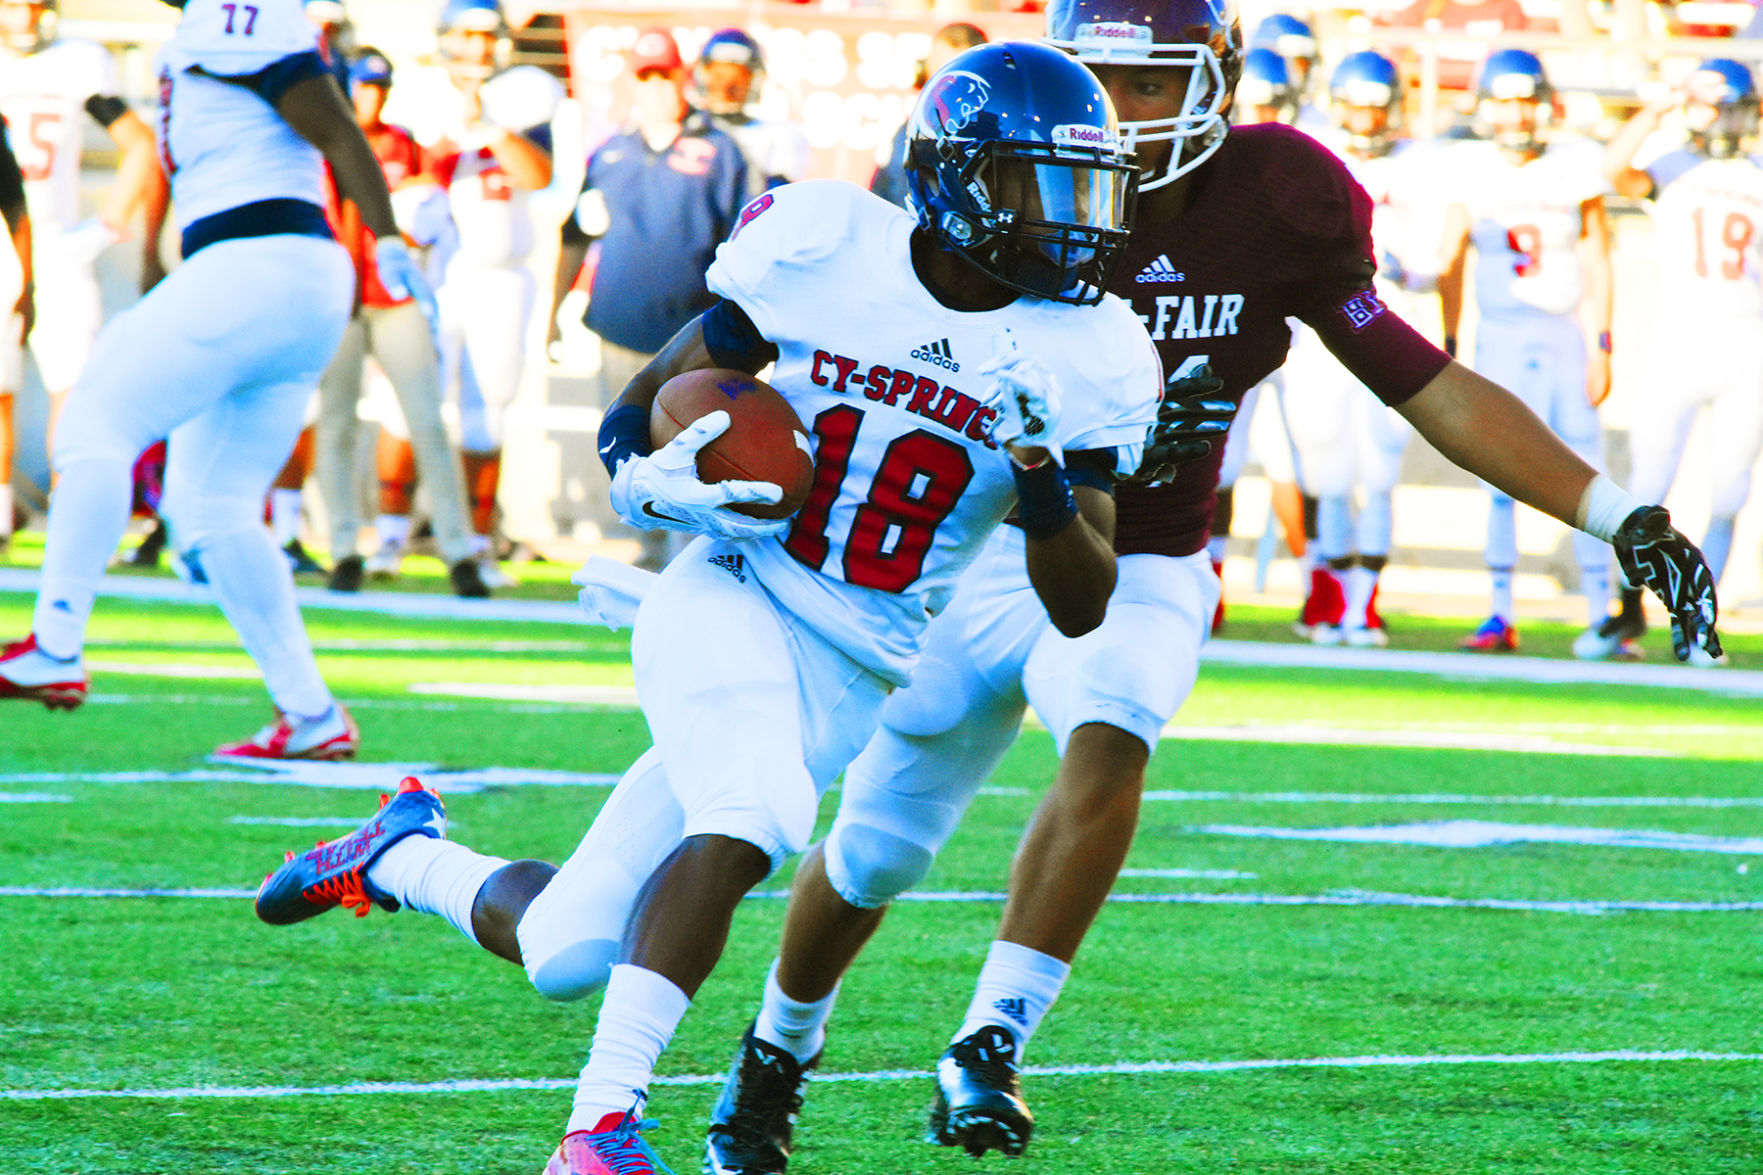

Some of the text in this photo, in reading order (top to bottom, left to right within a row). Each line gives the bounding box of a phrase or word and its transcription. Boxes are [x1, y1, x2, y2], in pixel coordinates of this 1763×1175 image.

[222, 4, 258, 35] 77
[3, 113, 63, 181] 5
[1069, 127, 1104, 142] Riddell
[1693, 206, 1754, 280] 19
[1135, 271, 1185, 283] adidas
[1121, 293, 1245, 340] -FAIR
[910, 348, 960, 373] adidas
[810, 349, 998, 450] CY-SPRING
[784, 403, 975, 593] 18
[708, 556, 747, 583] adidas
